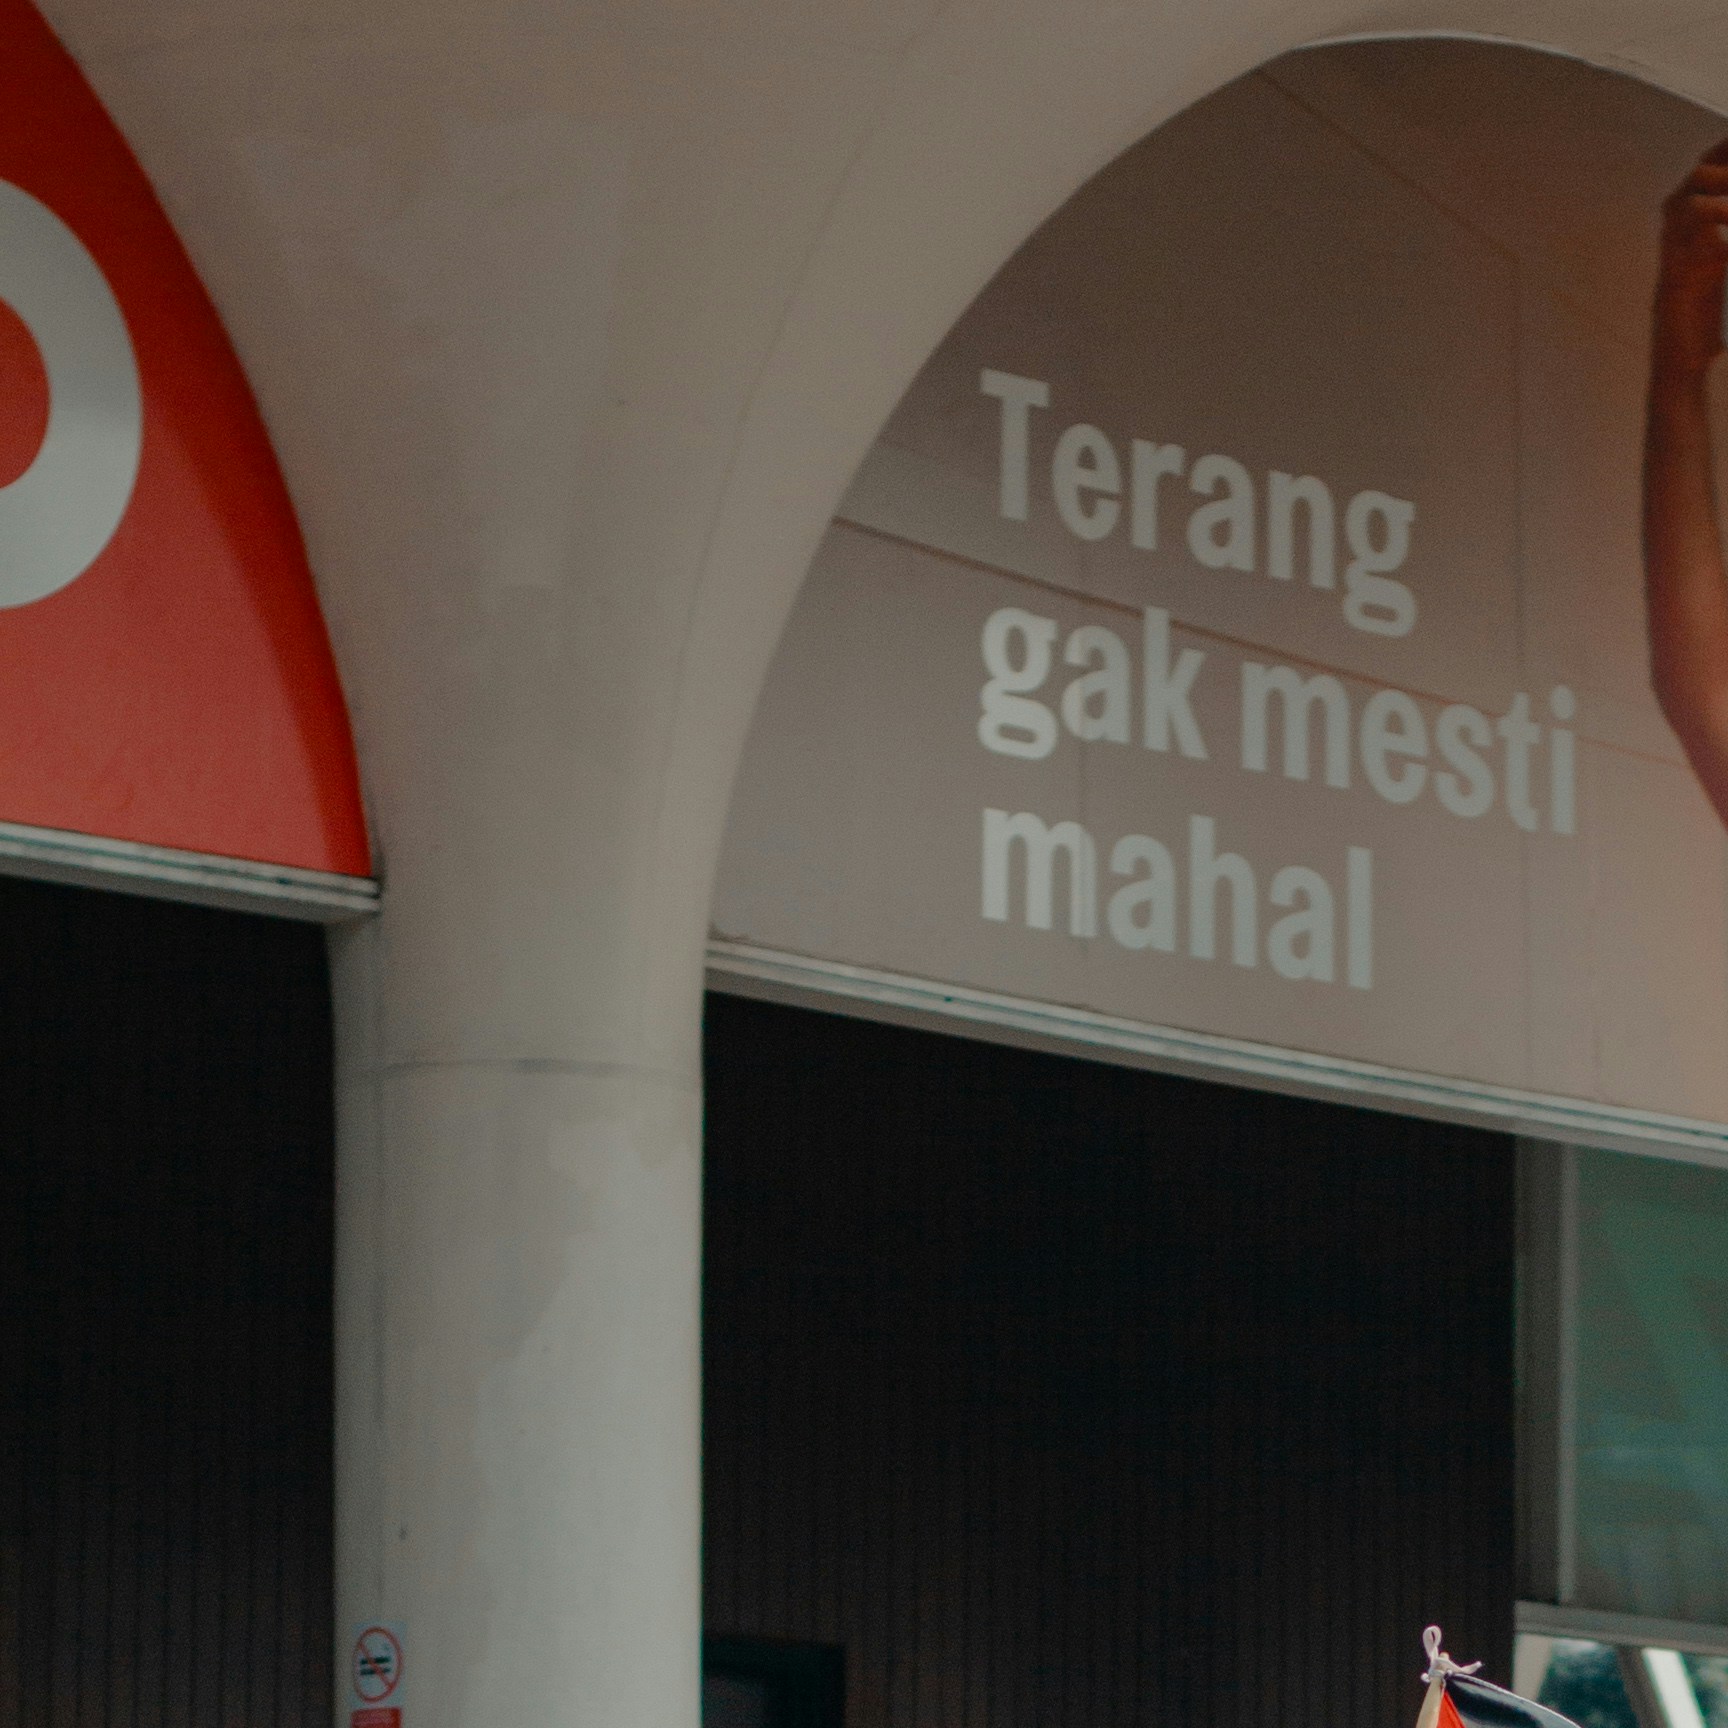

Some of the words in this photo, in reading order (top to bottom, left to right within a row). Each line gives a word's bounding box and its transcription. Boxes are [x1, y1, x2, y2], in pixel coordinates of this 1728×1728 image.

[980, 368, 1419, 637] Terang
[977, 605, 1208, 761] gak
[1240, 683, 1578, 836] mesti
[980, 806, 1374, 991] mahal
